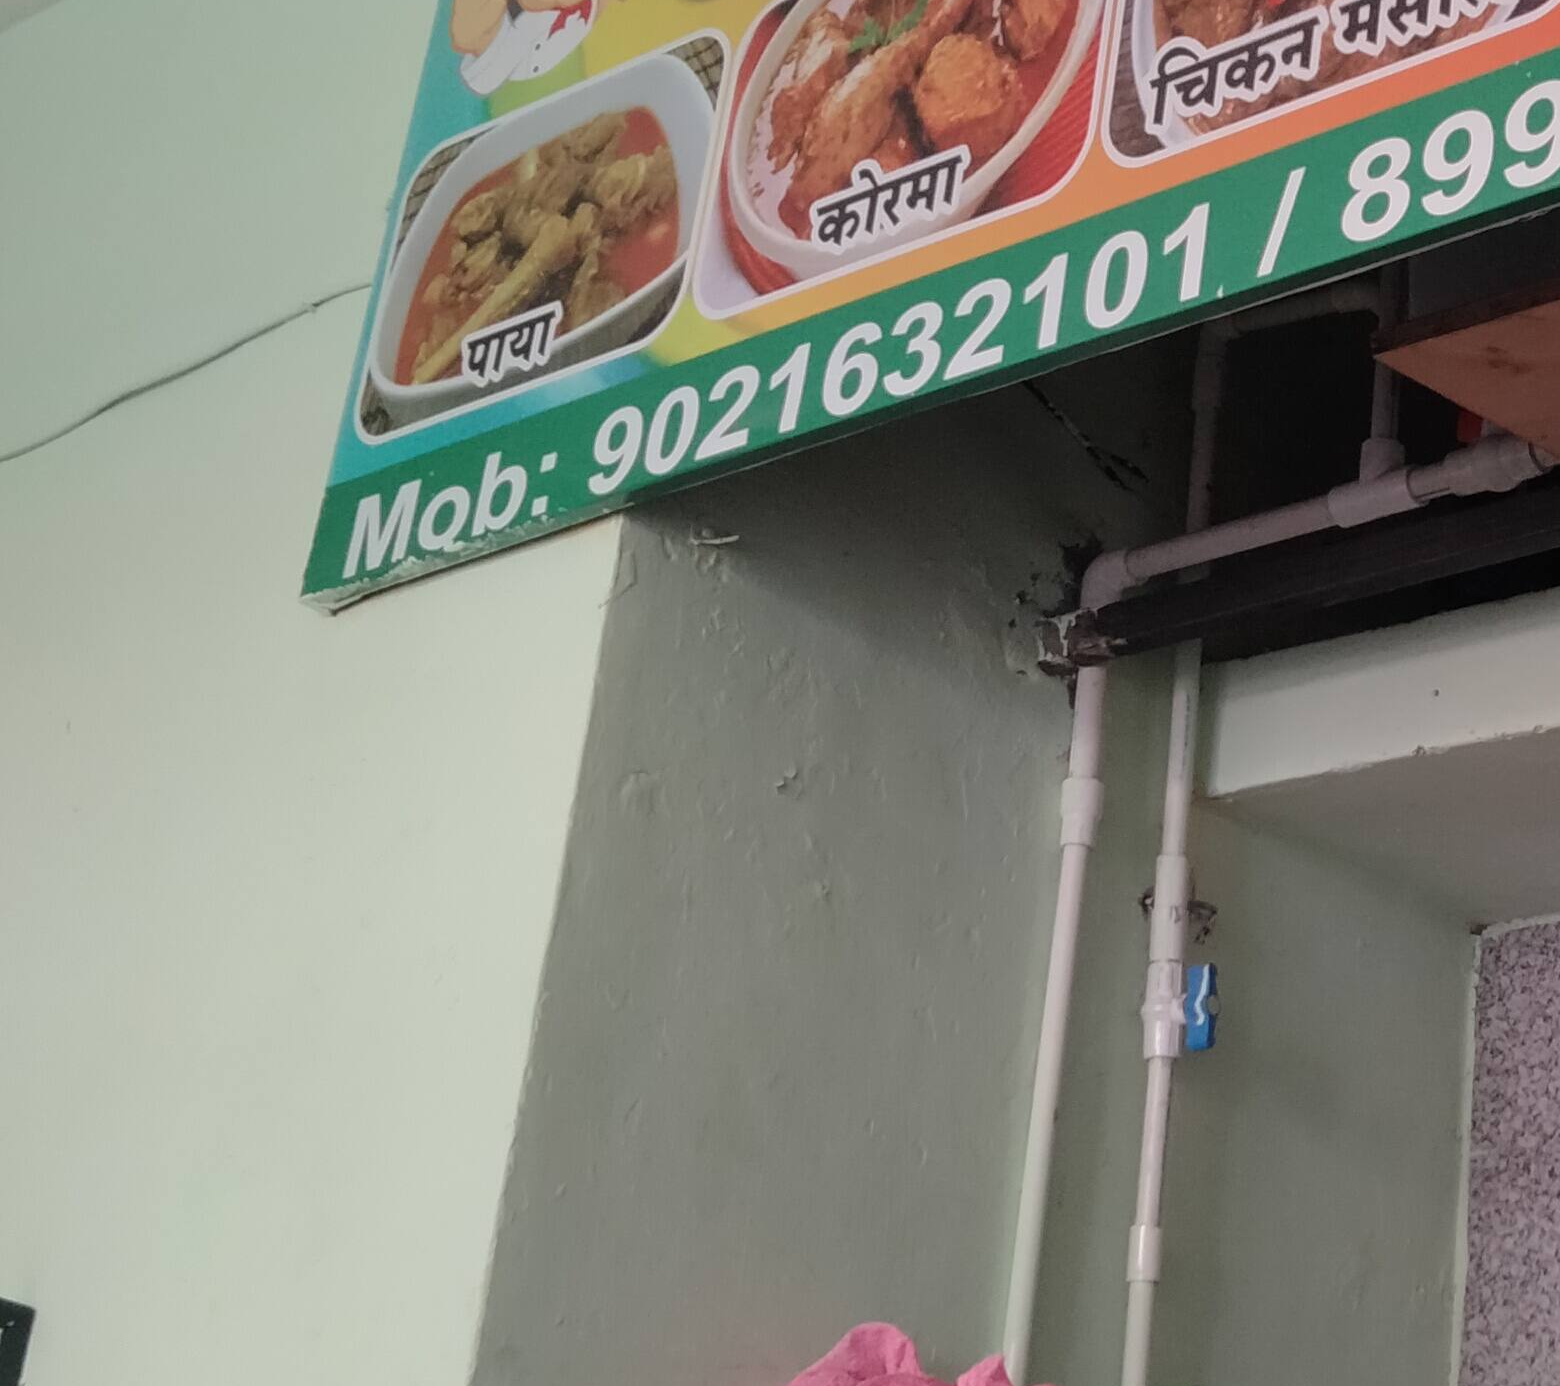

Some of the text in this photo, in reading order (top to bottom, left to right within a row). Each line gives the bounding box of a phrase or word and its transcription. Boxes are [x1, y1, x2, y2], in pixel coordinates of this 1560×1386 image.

[1153, 18, 1322, 128] चिकन
[816, 157, 963, 246] कोरमा
[341, 450, 557, 579] Mob:
[587, 198, 1213, 497] 9021632101
[465, 309, 560, 380] पाया
